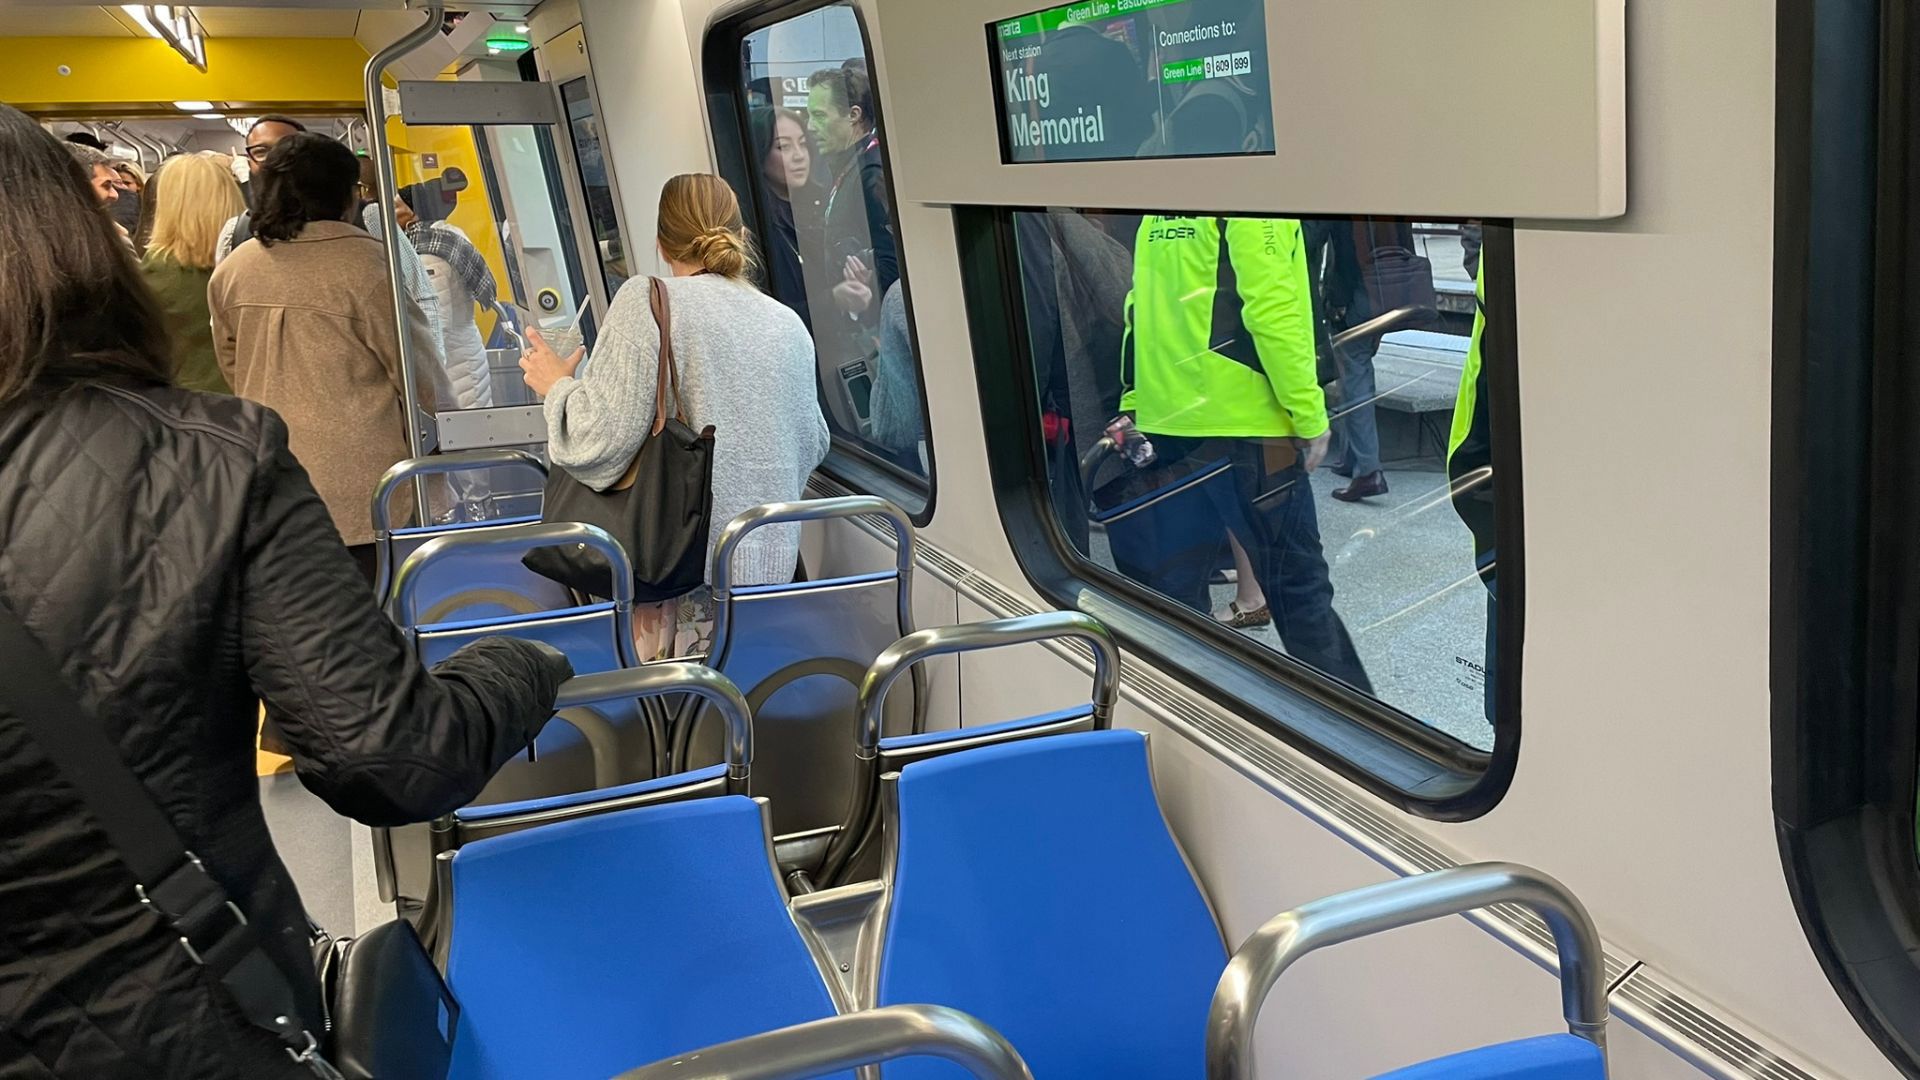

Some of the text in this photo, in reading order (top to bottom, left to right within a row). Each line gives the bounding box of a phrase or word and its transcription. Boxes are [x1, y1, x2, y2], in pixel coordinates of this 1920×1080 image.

[1066, 8, 1091, 21] Green
[1092, 2, 1110, 16] Line
[1117, 0, 1163, 11] Eastbo
[1159, 20, 1236, 47] Connections to:
[1002, 45, 1041, 62] Next station
[1163, 66, 1185, 79] Green
[1186, 64, 1202, 76] Line
[1205, 62, 1211, 74] 9
[1234, 56, 1249, 70] 899
[1005, 68, 1050, 108] King
[1011, 105, 1105, 147] Memorial
